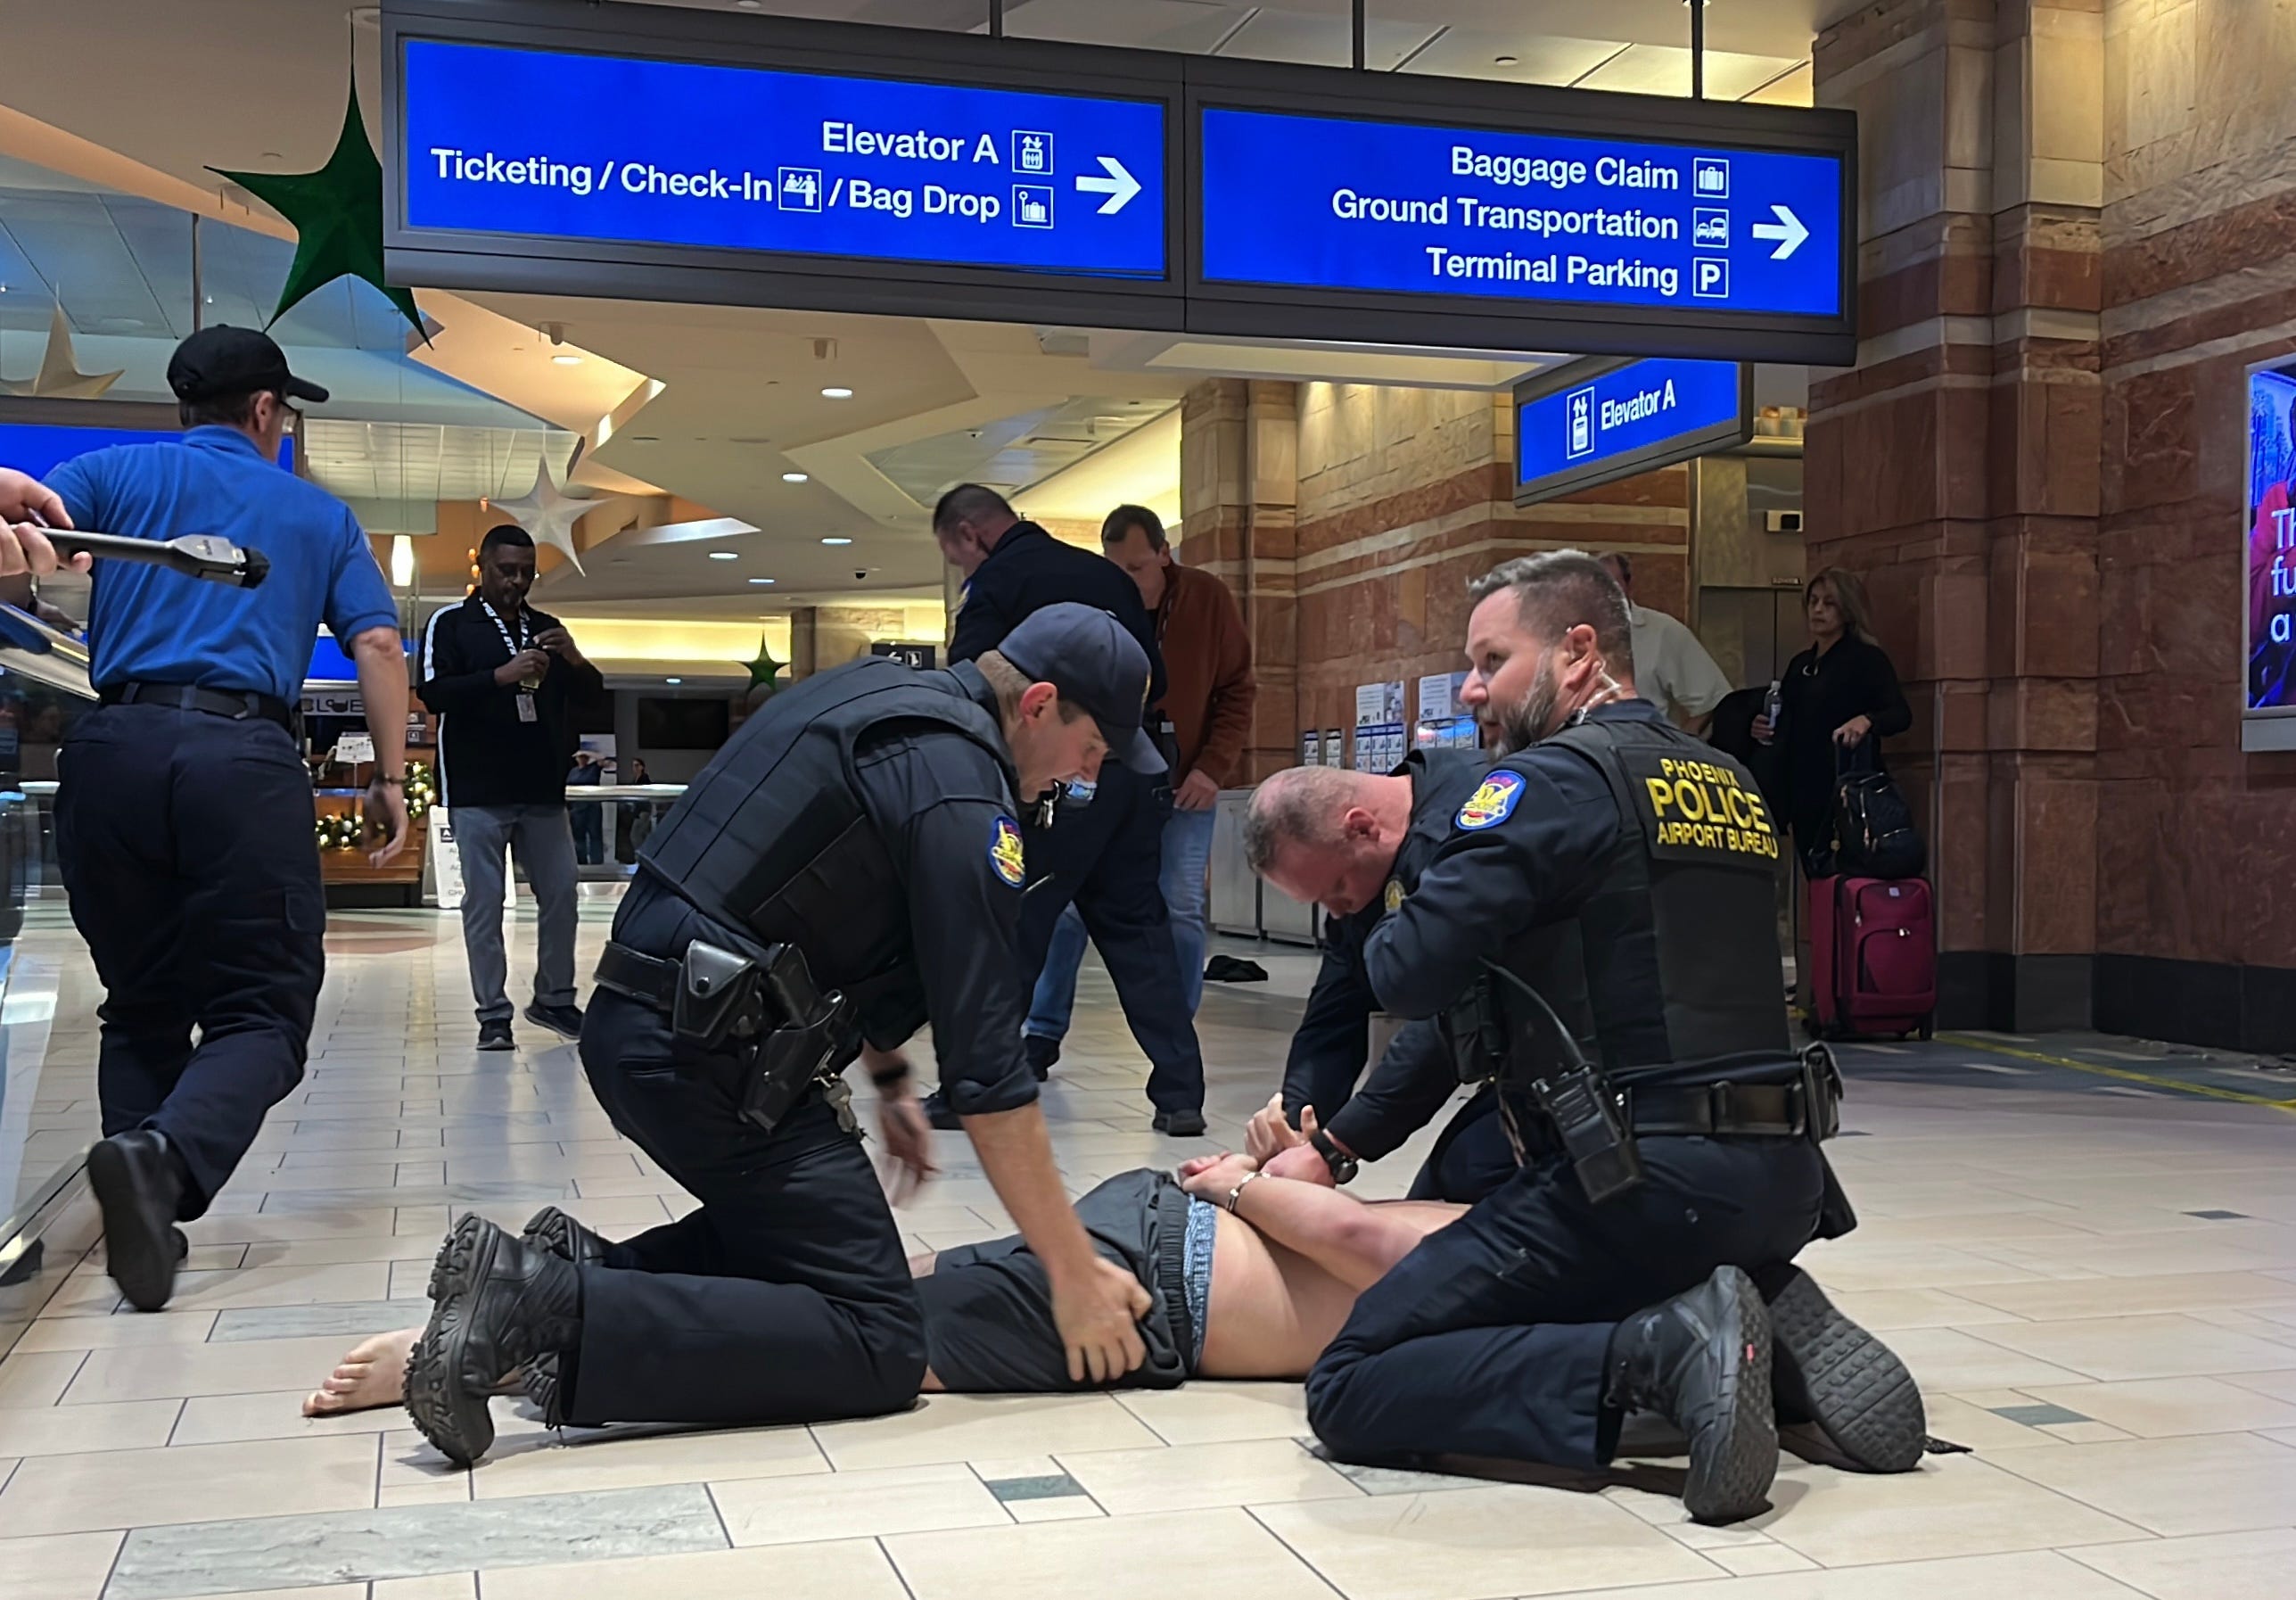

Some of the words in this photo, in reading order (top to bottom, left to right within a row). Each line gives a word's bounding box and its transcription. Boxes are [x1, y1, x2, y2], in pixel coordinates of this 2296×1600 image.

[823, 120, 966, 162] Elevator
[972, 134, 1000, 164] A
[430, 148, 592, 195] Ticketing
[597, 161, 614, 190] /
[621, 162, 772, 202] Check-In
[849, 179, 912, 219] Bag
[924, 185, 1000, 224] Drop
[1452, 145, 1587, 189] Baggage
[1595, 156, 1678, 190] Claim
[1332, 188, 1448, 225] Ground
[1456, 197, 1678, 240] Transportation
[1425, 246, 1557, 284] Terminal
[1567, 255, 1678, 296] Parking
[1601, 390, 1661, 431] Elevator
[1662, 378, 1676, 410] A
[2270, 613, 2291, 643] a
[1659, 758, 1741, 788] PHOENIX
[1645, 778, 1772, 833] POLICE
[1657, 821, 1725, 849] AIRPORT
[1727, 828, 1779, 861] BUREAU
